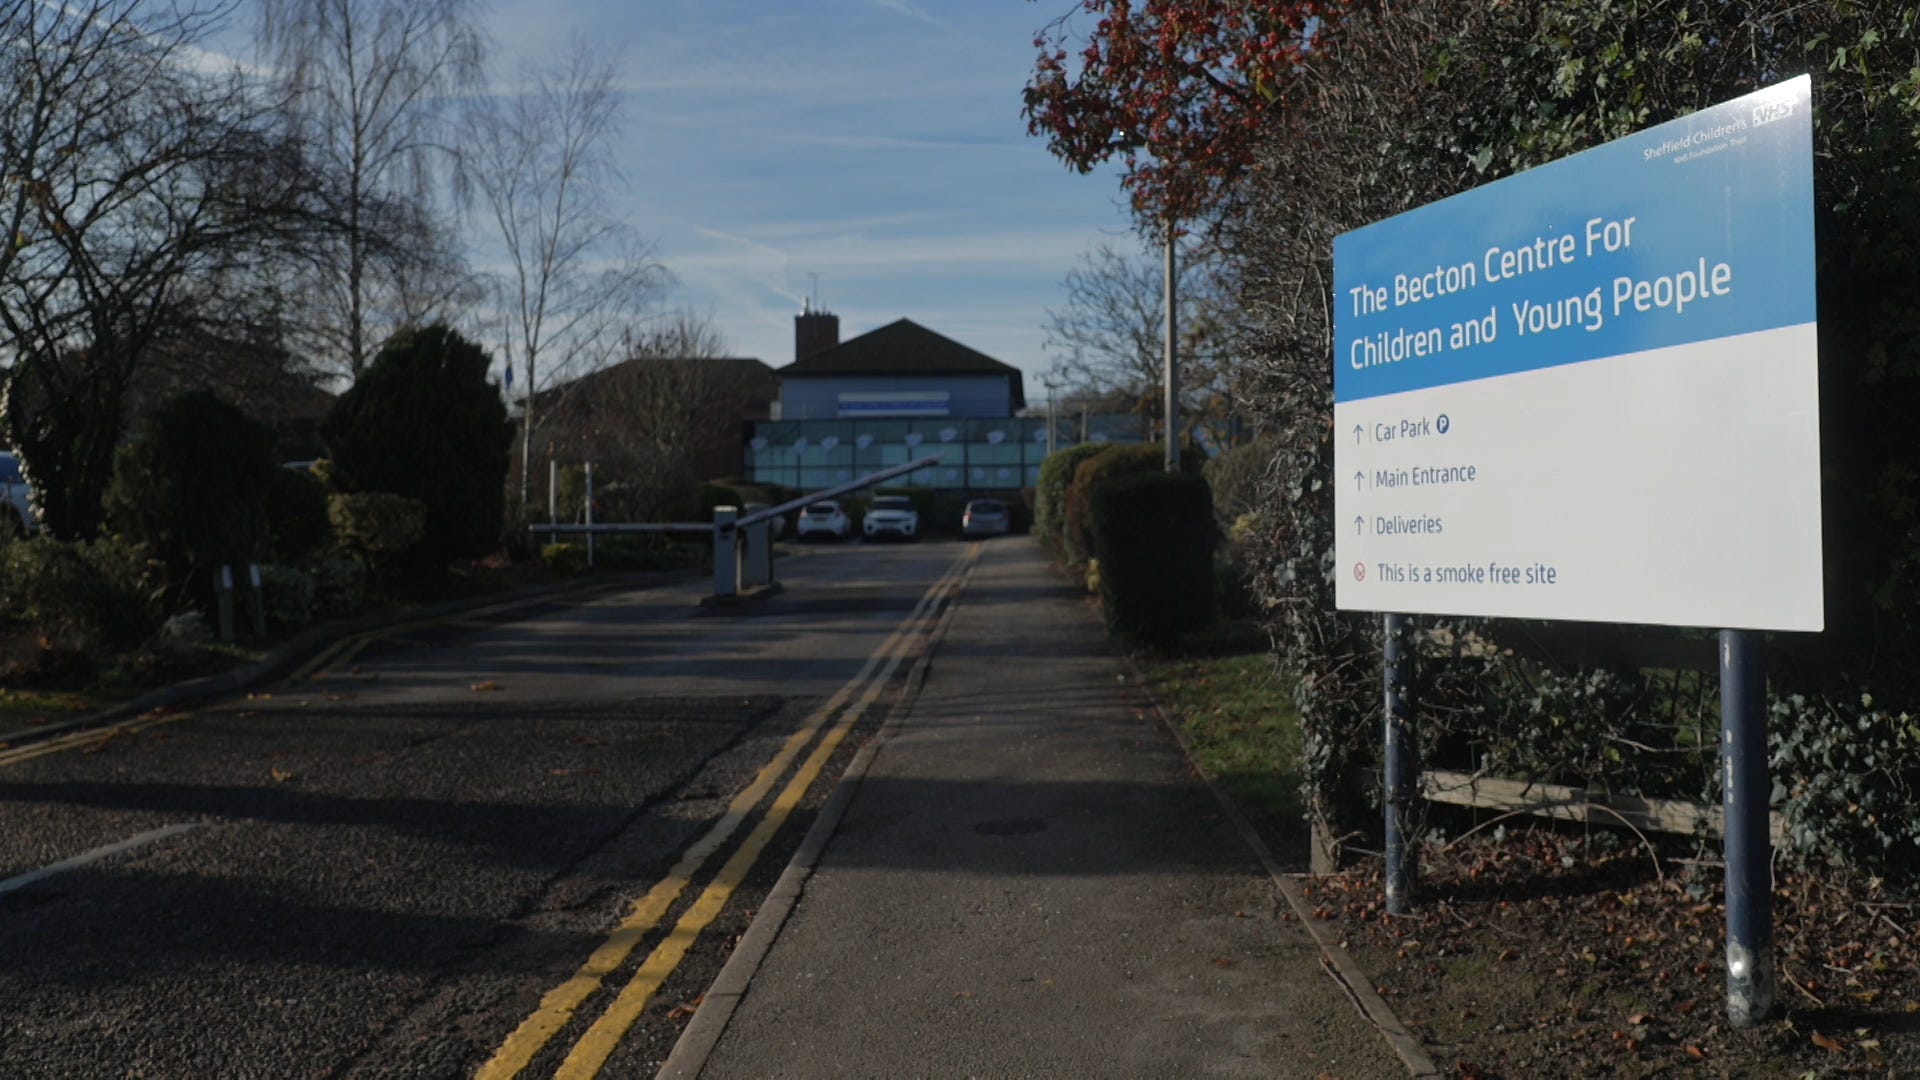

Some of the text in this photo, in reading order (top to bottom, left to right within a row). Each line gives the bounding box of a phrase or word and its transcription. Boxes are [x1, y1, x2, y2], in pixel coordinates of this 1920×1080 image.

[1643, 134, 1690, 160] Sheffield
[1756, 101, 1792, 124] NHS
[1349, 217, 1636, 317] The Becton Centre For
[1351, 257, 1731, 370] Children and Young People
[1375, 423, 1397, 442] Car
[1400, 417, 1430, 438] Park
[1376, 464, 1476, 488] Main Entrance
[1376, 514, 1443, 535] Deliveries
[1378, 563, 1557, 584] This is a smoke free site
